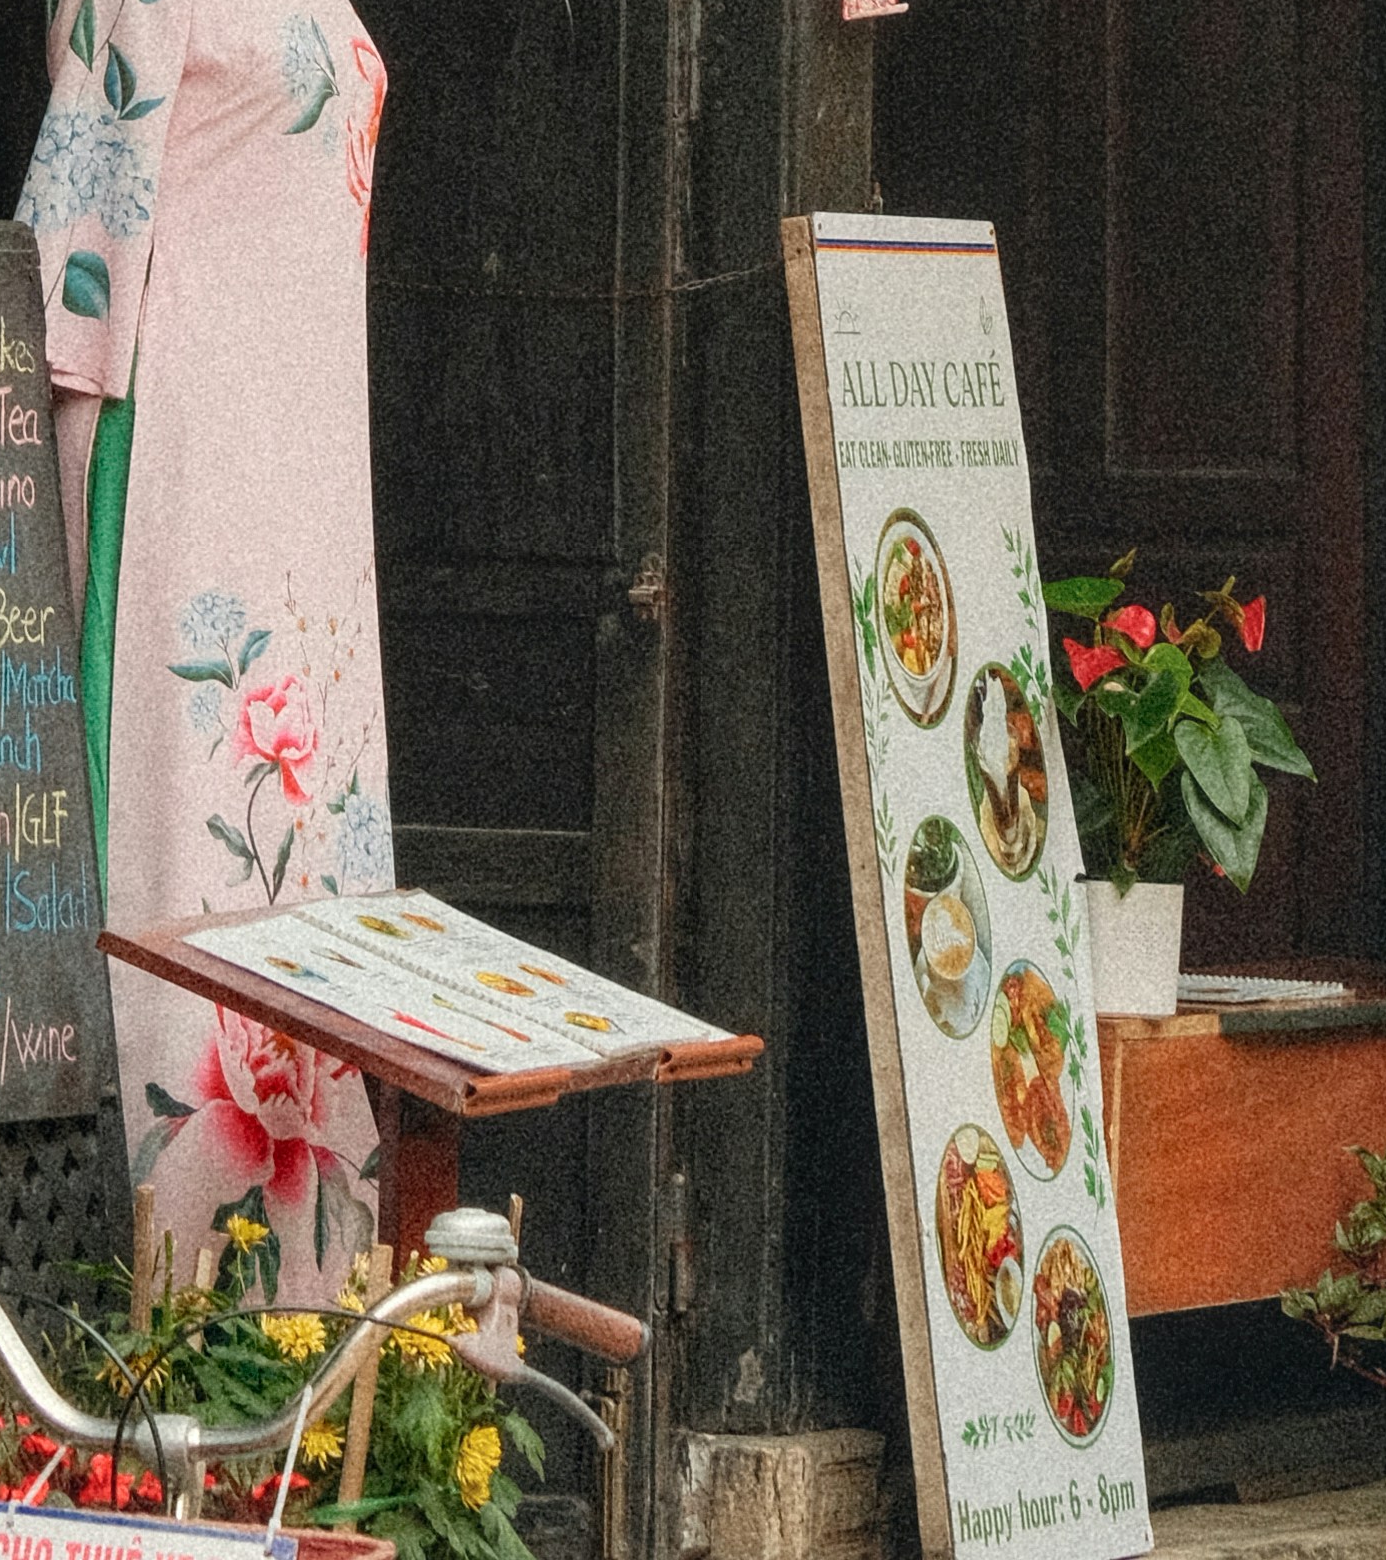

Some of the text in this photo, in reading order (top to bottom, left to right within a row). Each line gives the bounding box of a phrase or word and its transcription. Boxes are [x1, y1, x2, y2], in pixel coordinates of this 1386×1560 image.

[840, 349, 1006, 409] ALL DAY CAFÉ
[838, 440, 857, 469] EAT
[960, 439, 992, 468] FRESH
[991, 439, 1019, 467] DAILY
[957, 1498, 1013, 1547] Happy
[1017, 1489, 1066, 1531] hour:
[1068, 1478, 1082, 1521] 6
[1097, 1473, 1136, 1525] 8pm
